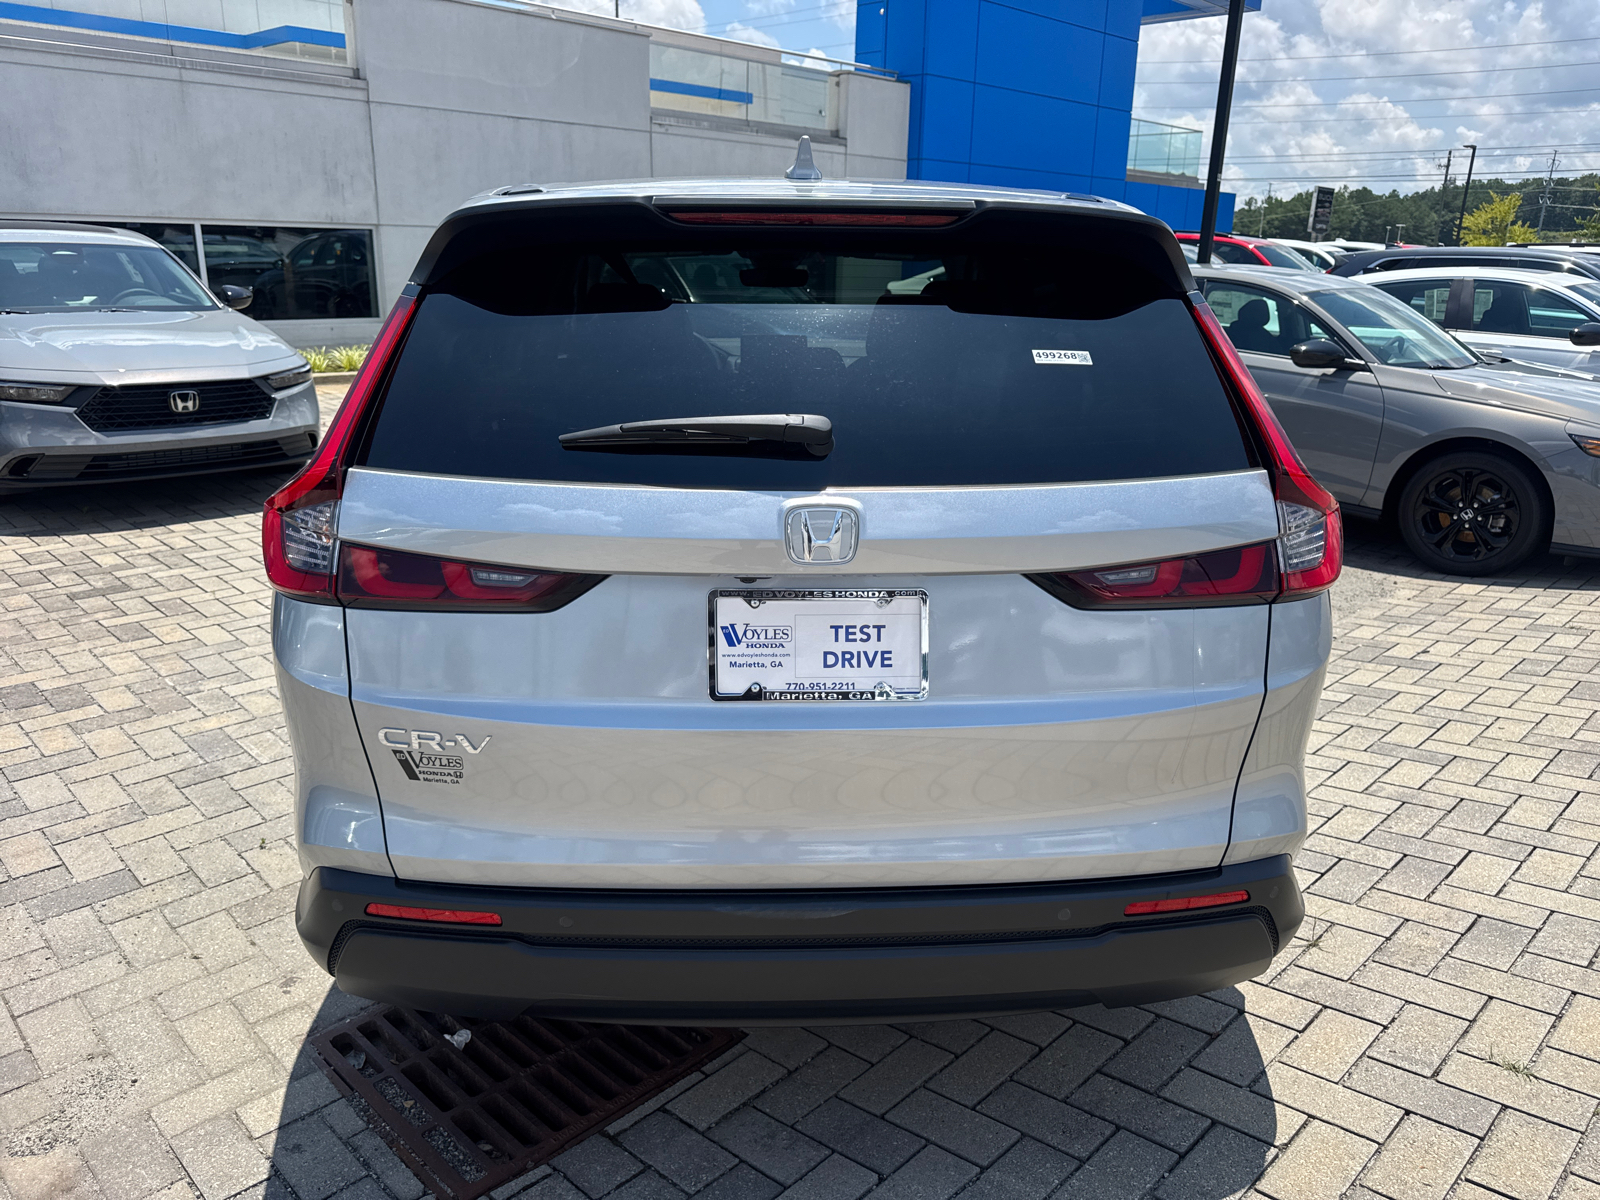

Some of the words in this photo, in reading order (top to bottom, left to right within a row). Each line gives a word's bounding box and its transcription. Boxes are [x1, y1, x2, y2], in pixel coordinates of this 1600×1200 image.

[1036, 351, 1077, 359] 499268
[729, 623, 790, 645] VOYLES
[829, 624, 886, 643] TEST
[729, 660, 768, 669] Marietta,
[770, 660, 784, 668] GA
[822, 650, 893, 668] DRIVE
[785, 682, 856, 690] 770-951-2211
[766, 691, 843, 700] Marietta,
[848, 691, 873, 700] GA
[378, 726, 493, 754] CR-V
[406, 750, 463, 769] VOYLES
[418, 769, 454, 778] HONDA
